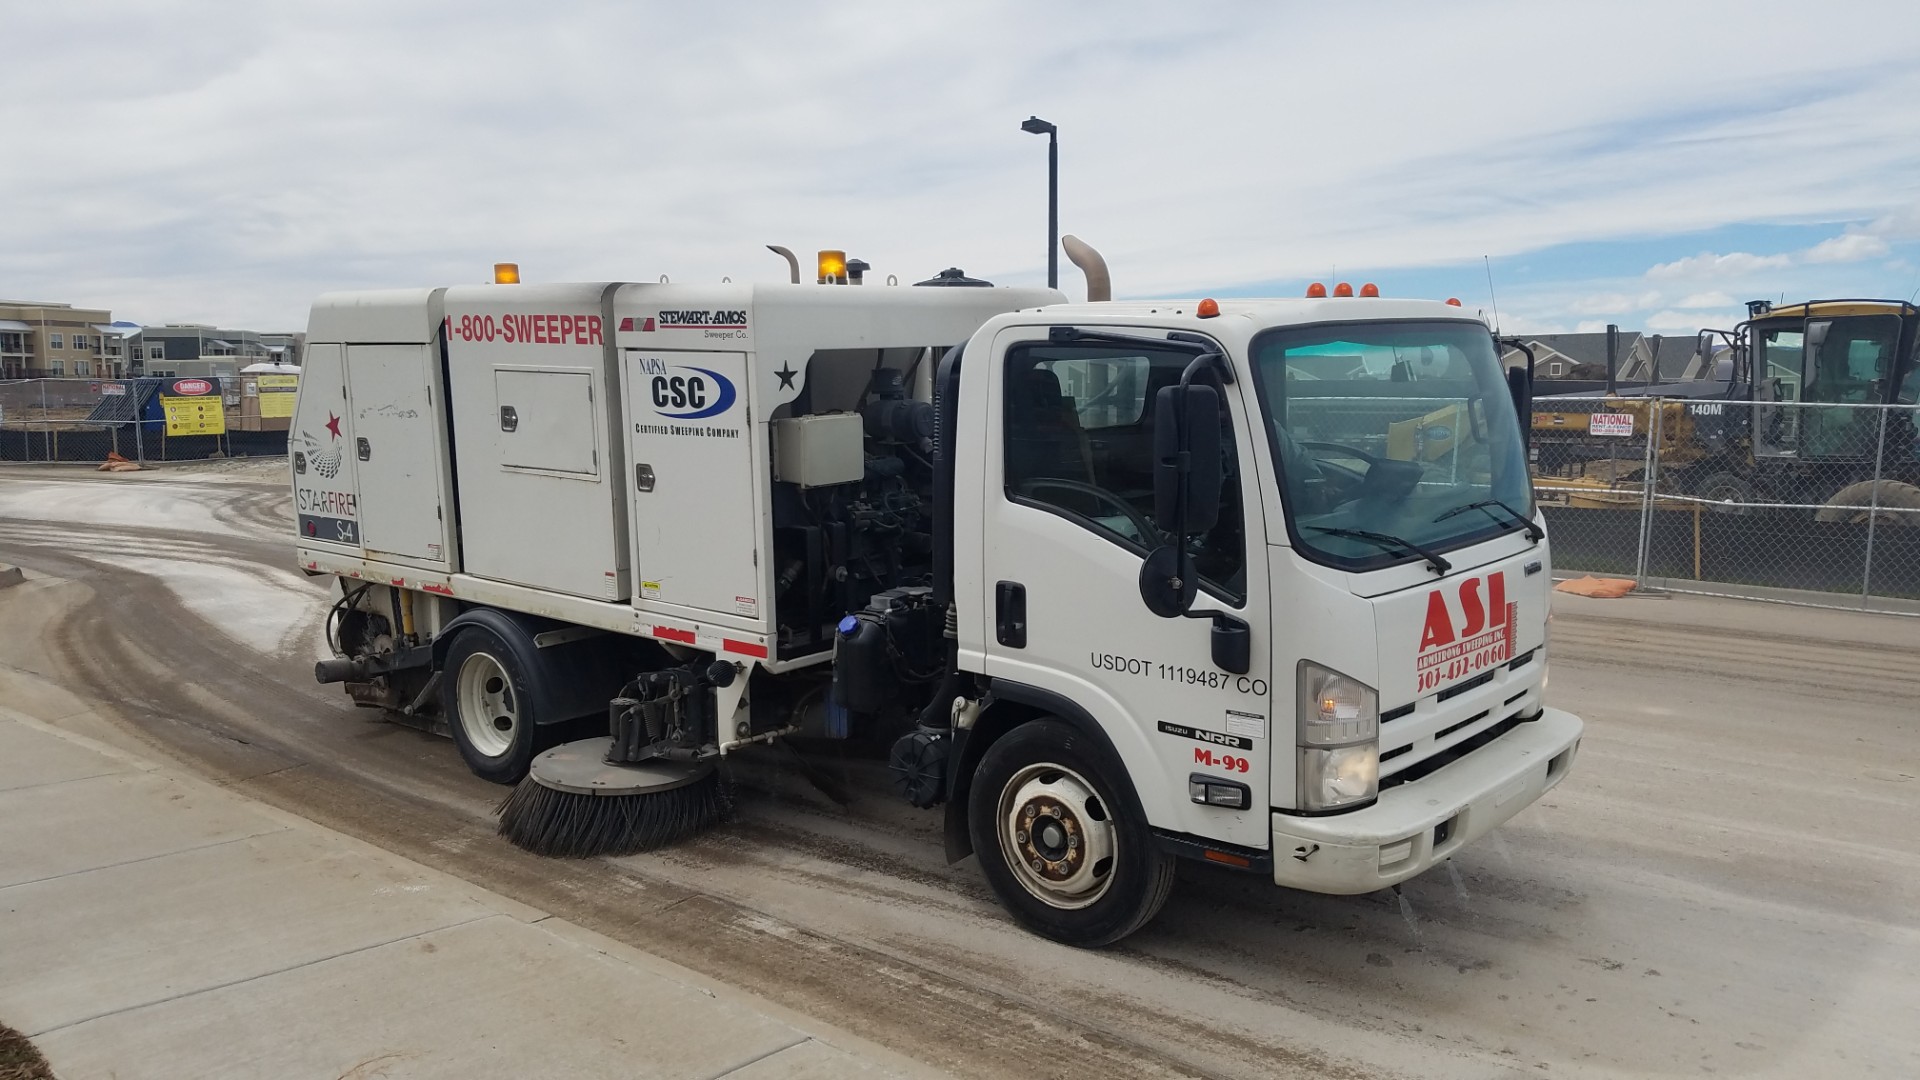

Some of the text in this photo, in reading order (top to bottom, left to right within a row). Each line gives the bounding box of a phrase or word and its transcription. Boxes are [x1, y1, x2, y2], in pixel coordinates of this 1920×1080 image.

[445, 314, 603, 345] 1-800-SWEEPER
[704, 330, 749, 340] Sweeper Co.
[639, 359, 667, 375] NAPSA
[180, 382, 206, 390] DANGER
[652, 376, 706, 409] CSC
[1592, 414, 1632, 425] NATIONAL
[1690, 404, 1722, 415] 140M
[635, 423, 739, 439] CERTIFIED SWEEPING COMPANY
[299, 488, 355, 517] STARFIRE
[1419, 570, 1506, 654] ASI
[1417, 645, 1461, 670] ARMSTRONG
[1462, 633, 1493, 653] SWEEPING
[1091, 652, 1268, 696] USDOT 1119487 CO
[1417, 643, 1505, 693] 303-432-0060
[1164, 725, 1240, 748] ISUZU NRR
[1194, 747, 1249, 773] M-99
